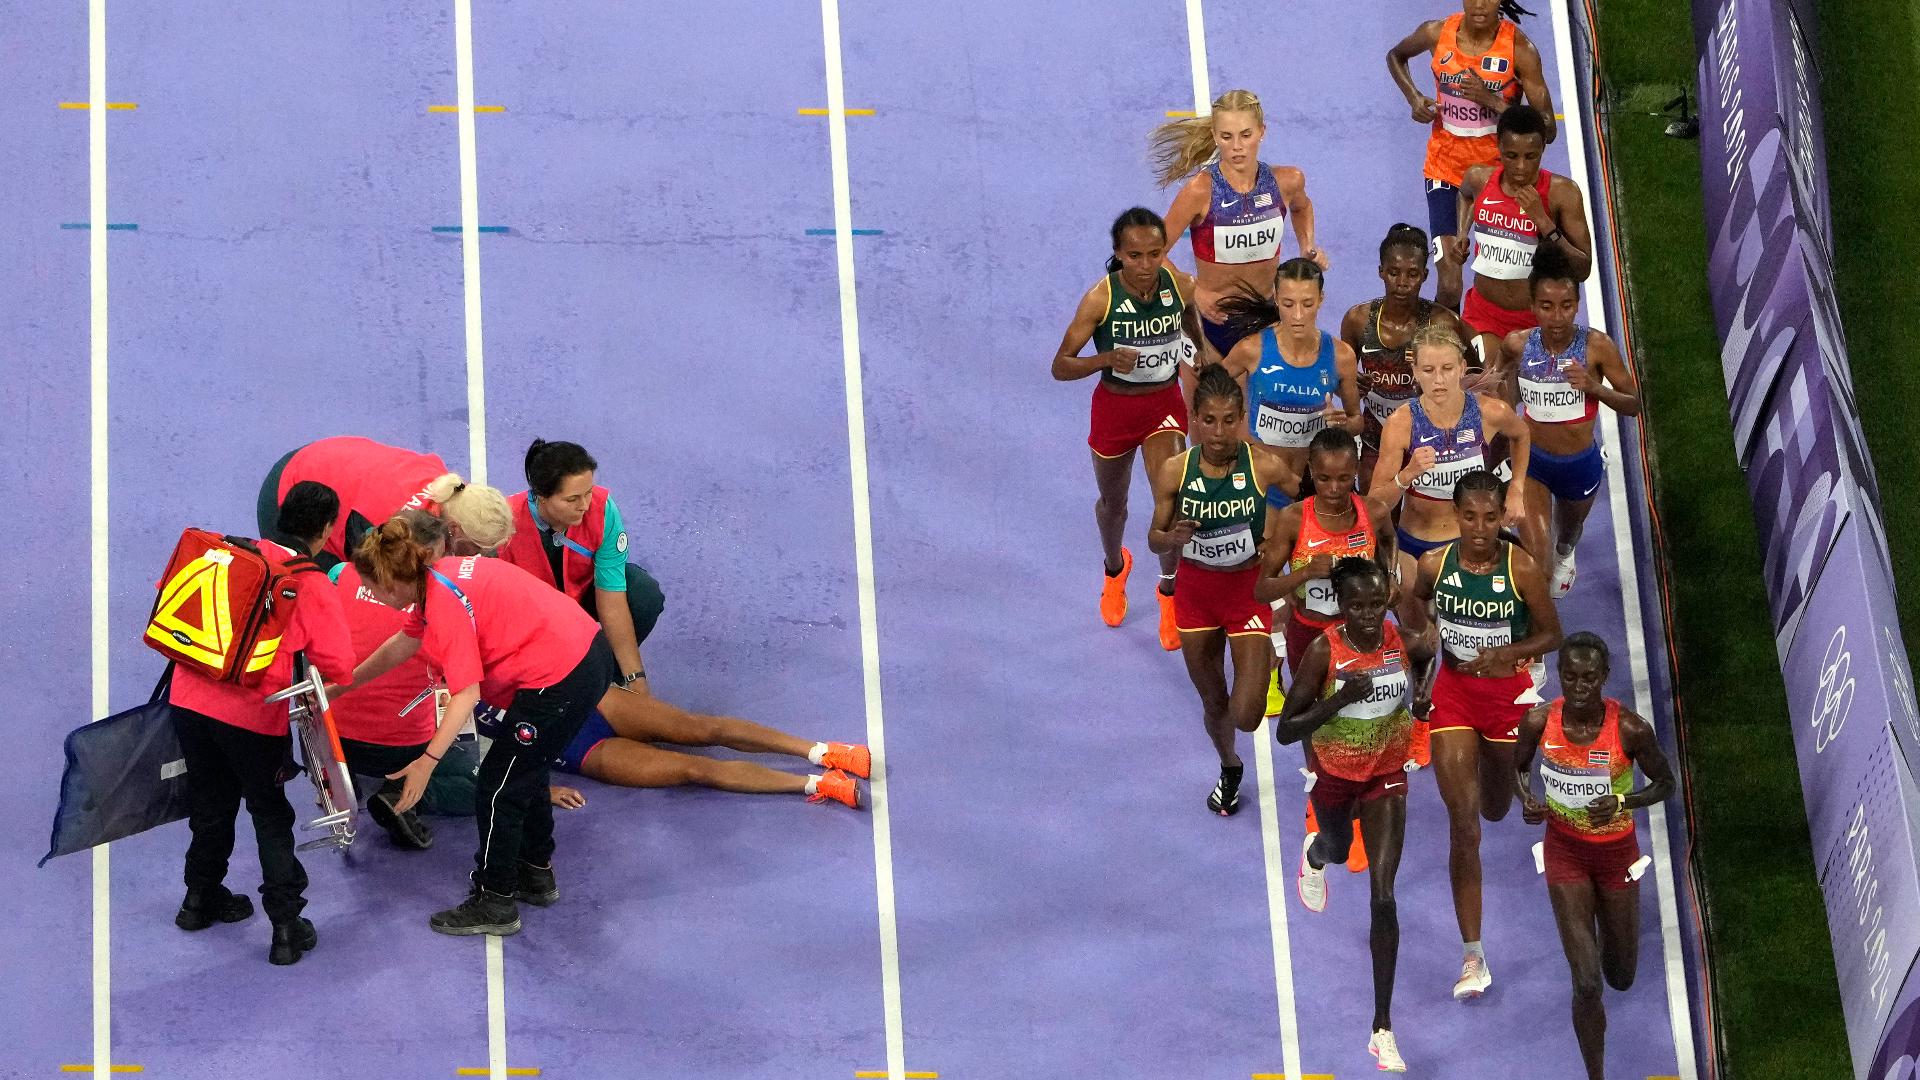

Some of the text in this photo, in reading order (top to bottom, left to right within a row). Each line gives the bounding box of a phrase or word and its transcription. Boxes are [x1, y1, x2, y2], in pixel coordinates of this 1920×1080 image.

[1724, 89, 1747, 193] 2024
[1225, 228, 1276, 249] VALBY
[1112, 311, 1182, 338] ETHIOPIA
[1136, 348, 1179, 369] EGAY
[1273, 382, 1321, 396] ITALIA
[1182, 496, 1256, 518] ETHIOPIA
[1190, 538, 1247, 559] TESFAY
[1436, 590, 1515, 619] ETHIOPIA
[1542, 773, 1611, 796] KIPKEMBOI
[1863, 905, 1892, 1020] 2024
